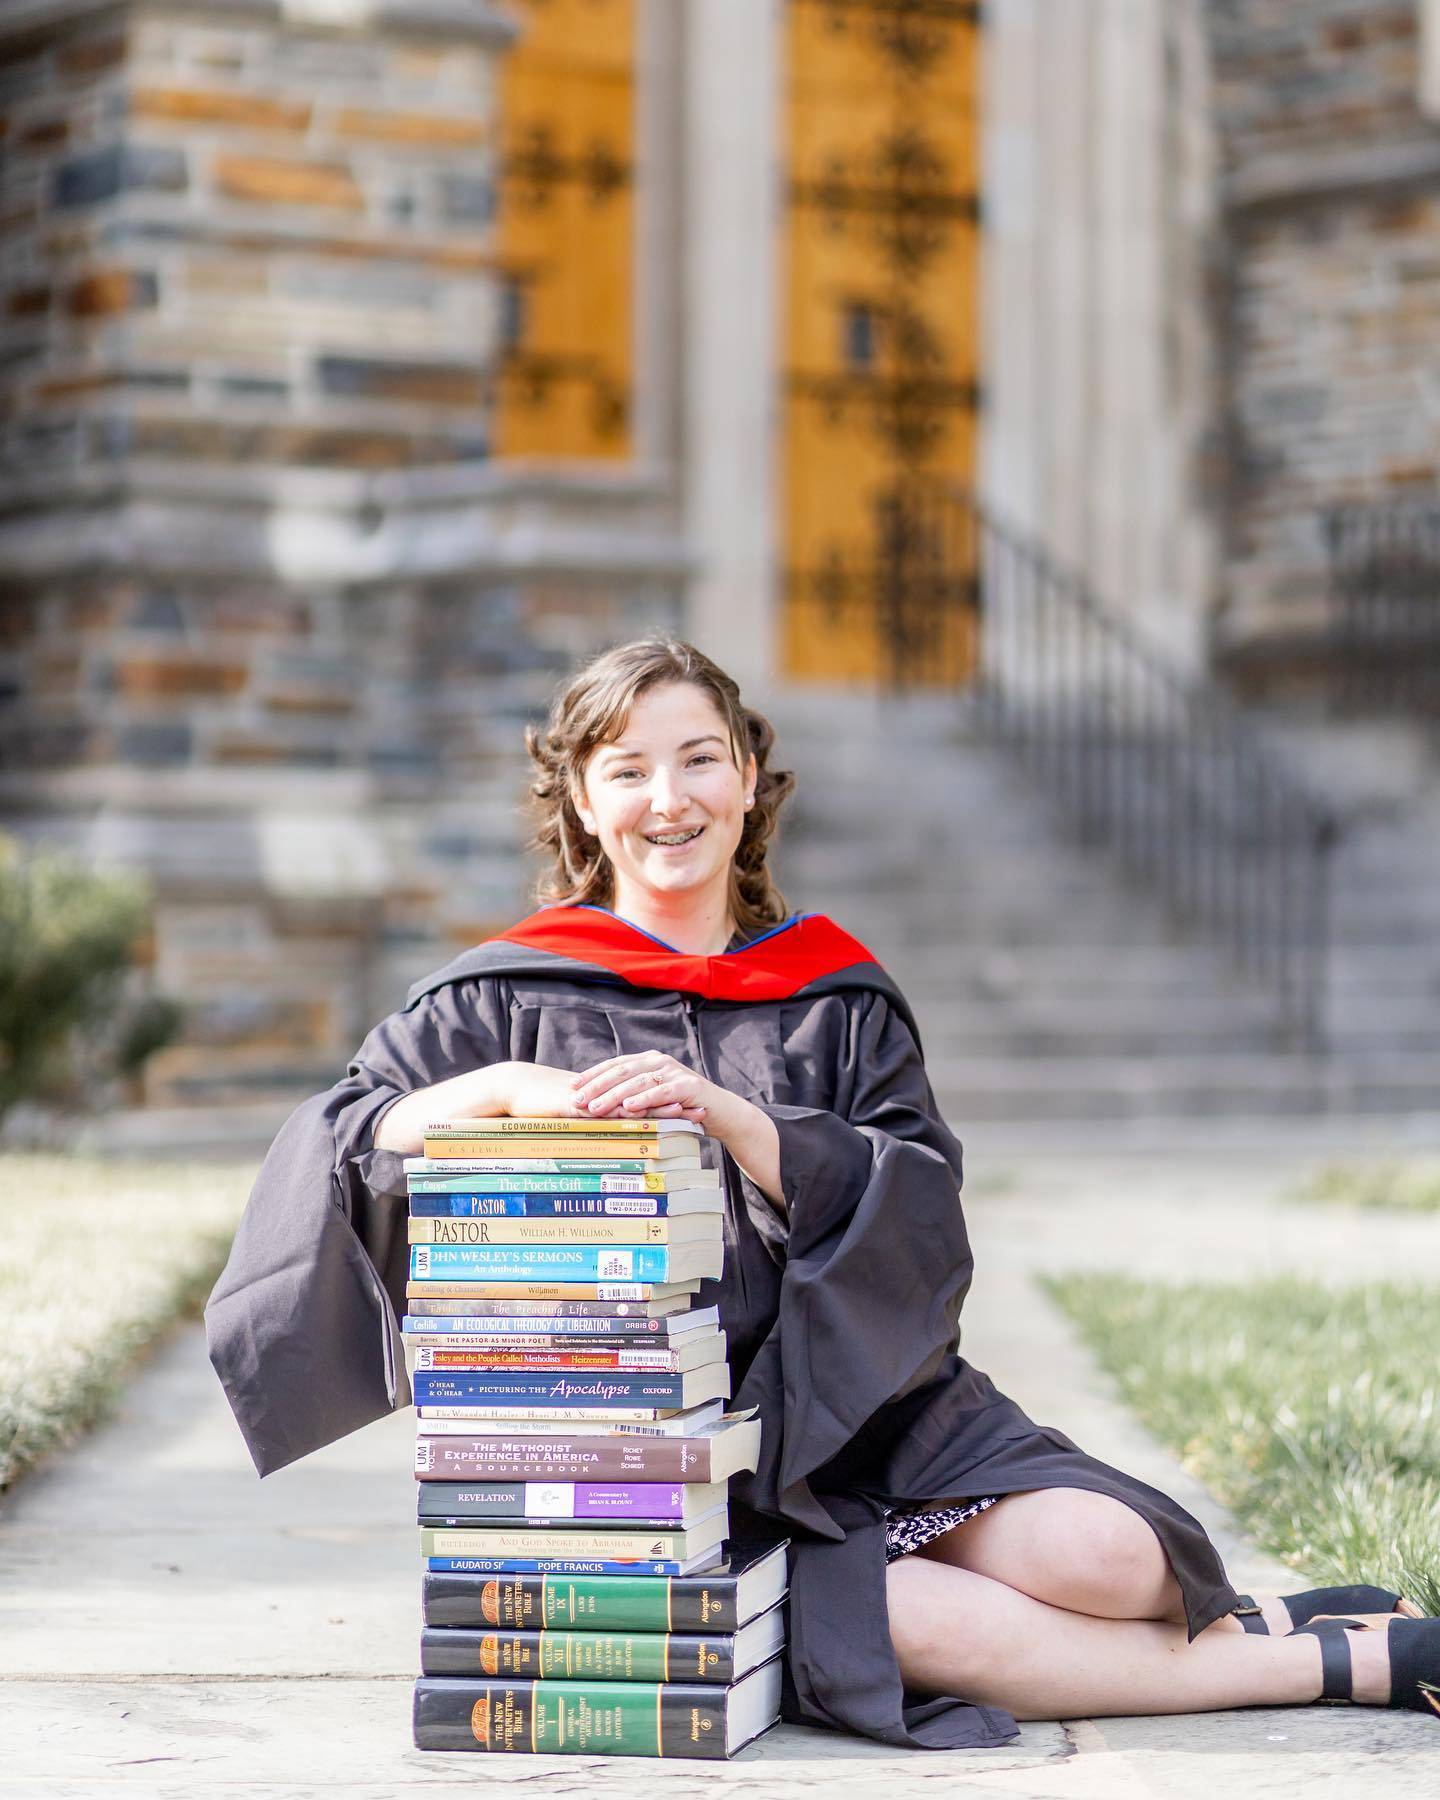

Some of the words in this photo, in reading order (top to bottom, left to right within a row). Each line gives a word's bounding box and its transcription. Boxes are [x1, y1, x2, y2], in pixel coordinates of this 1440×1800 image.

[501, 1123, 570, 1131] ECOWOMANISM
[497, 1178, 520, 1191] The
[521, 1178, 557, 1191] Poet's
[560, 1177, 584, 1191] Gift
[471, 1197, 506, 1215] PASTOR
[554, 1199, 602, 1213] WILLIMO
[433, 1219, 490, 1243] PASTOR
[520, 1228, 556, 1237] WILLIAM
[558, 1228, 568, 1237] H.
[570, 1228, 614, 1238] WILLIMON
[418, 1252, 428, 1271] UM
[430, 1251, 458, 1262] OHN
[460, 1251, 520, 1262] WESLEY'S
[522, 1251, 583, 1263] SERMONS
[473, 1265, 488, 1273] An
[489, 1264, 533, 1275] Anthology
[491, 1303, 509, 1314] The
[516, 1303, 563, 1317] Preaching
[569, 1302, 589, 1316] Life
[452, 1319, 464, 1331] AN
[466, 1319, 510, 1331] ECOLOGICAL
[513, 1319, 551, 1332] THEOLOGY
[555, 1319, 564, 1332] OF
[567, 1320, 611, 1332] LIBERATION
[421, 1348, 431, 1367] UM
[433, 1353, 452, 1362] esley
[453, 1354, 464, 1362] and
[466, 1354, 476, 1362] the
[477, 1354, 500, 1363] People
[501, 1354, 523, 1362] Called
[524, 1354, 560, 1363] Methodists
[571, 1355, 612, 1364] Heitzenrater
[429, 1380, 455, 1388] O'HEAR
[549, 1379, 631, 1400] Apocalypse
[642, 1387, 673, 1395] OXFORD
[532, 1423, 551, 1431] Storm
[472, 1442, 498, 1452] THE
[502, 1443, 572, 1453] METHODIST
[622, 1446, 643, 1454] RICHEY
[417, 1446, 427, 1465] UM
[444, 1450, 521, 1460] EXPERIENCE
[525, 1452, 540, 1461] IN
[542, 1453, 599, 1462] AMERICA
[453, 1463, 461, 1471] A
[475, 1463, 589, 1472] SOURCEBOOK
[458, 1493, 515, 1502] REVELATION
[498, 1537, 518, 1546] AND
[521, 1537, 542, 1547] GOD
[545, 1537, 572, 1547] SPOKE
[577, 1539, 588, 1547] TO
[591, 1537, 633, 1547] ABRAHAM
[451, 1560, 492, 1570] LAUDATO
[493, 1561, 505, 1570] SI'
[537, 1562, 561, 1571] POPE
[564, 1562, 603, 1572] FRANCIS
[504, 1585, 512, 1604] NEW
[524, 1592, 532, 1614] BIBLE
[547, 1586, 556, 1620] VOLUME
[557, 1598, 566, 1609] IX
[701, 1590, 709, 1623] Abingdon
[503, 1642, 511, 1656] NEW
[522, 1648, 530, 1663] BIBLE
[555, 1649, 564, 1663] XII
[503, 1656, 511, 1667] THE
[698, 1642, 706, 1676] Abingdon
[494, 1701, 503, 1722] NEW
[505, 1689, 514, 1751] INTERPRETER'S
[514, 1709, 523, 1733] BIBLE
[537, 1704, 546, 1738] VOLUME
[690, 1708, 699, 1742] Abingdon
[495, 1723, 504, 1741] THE
